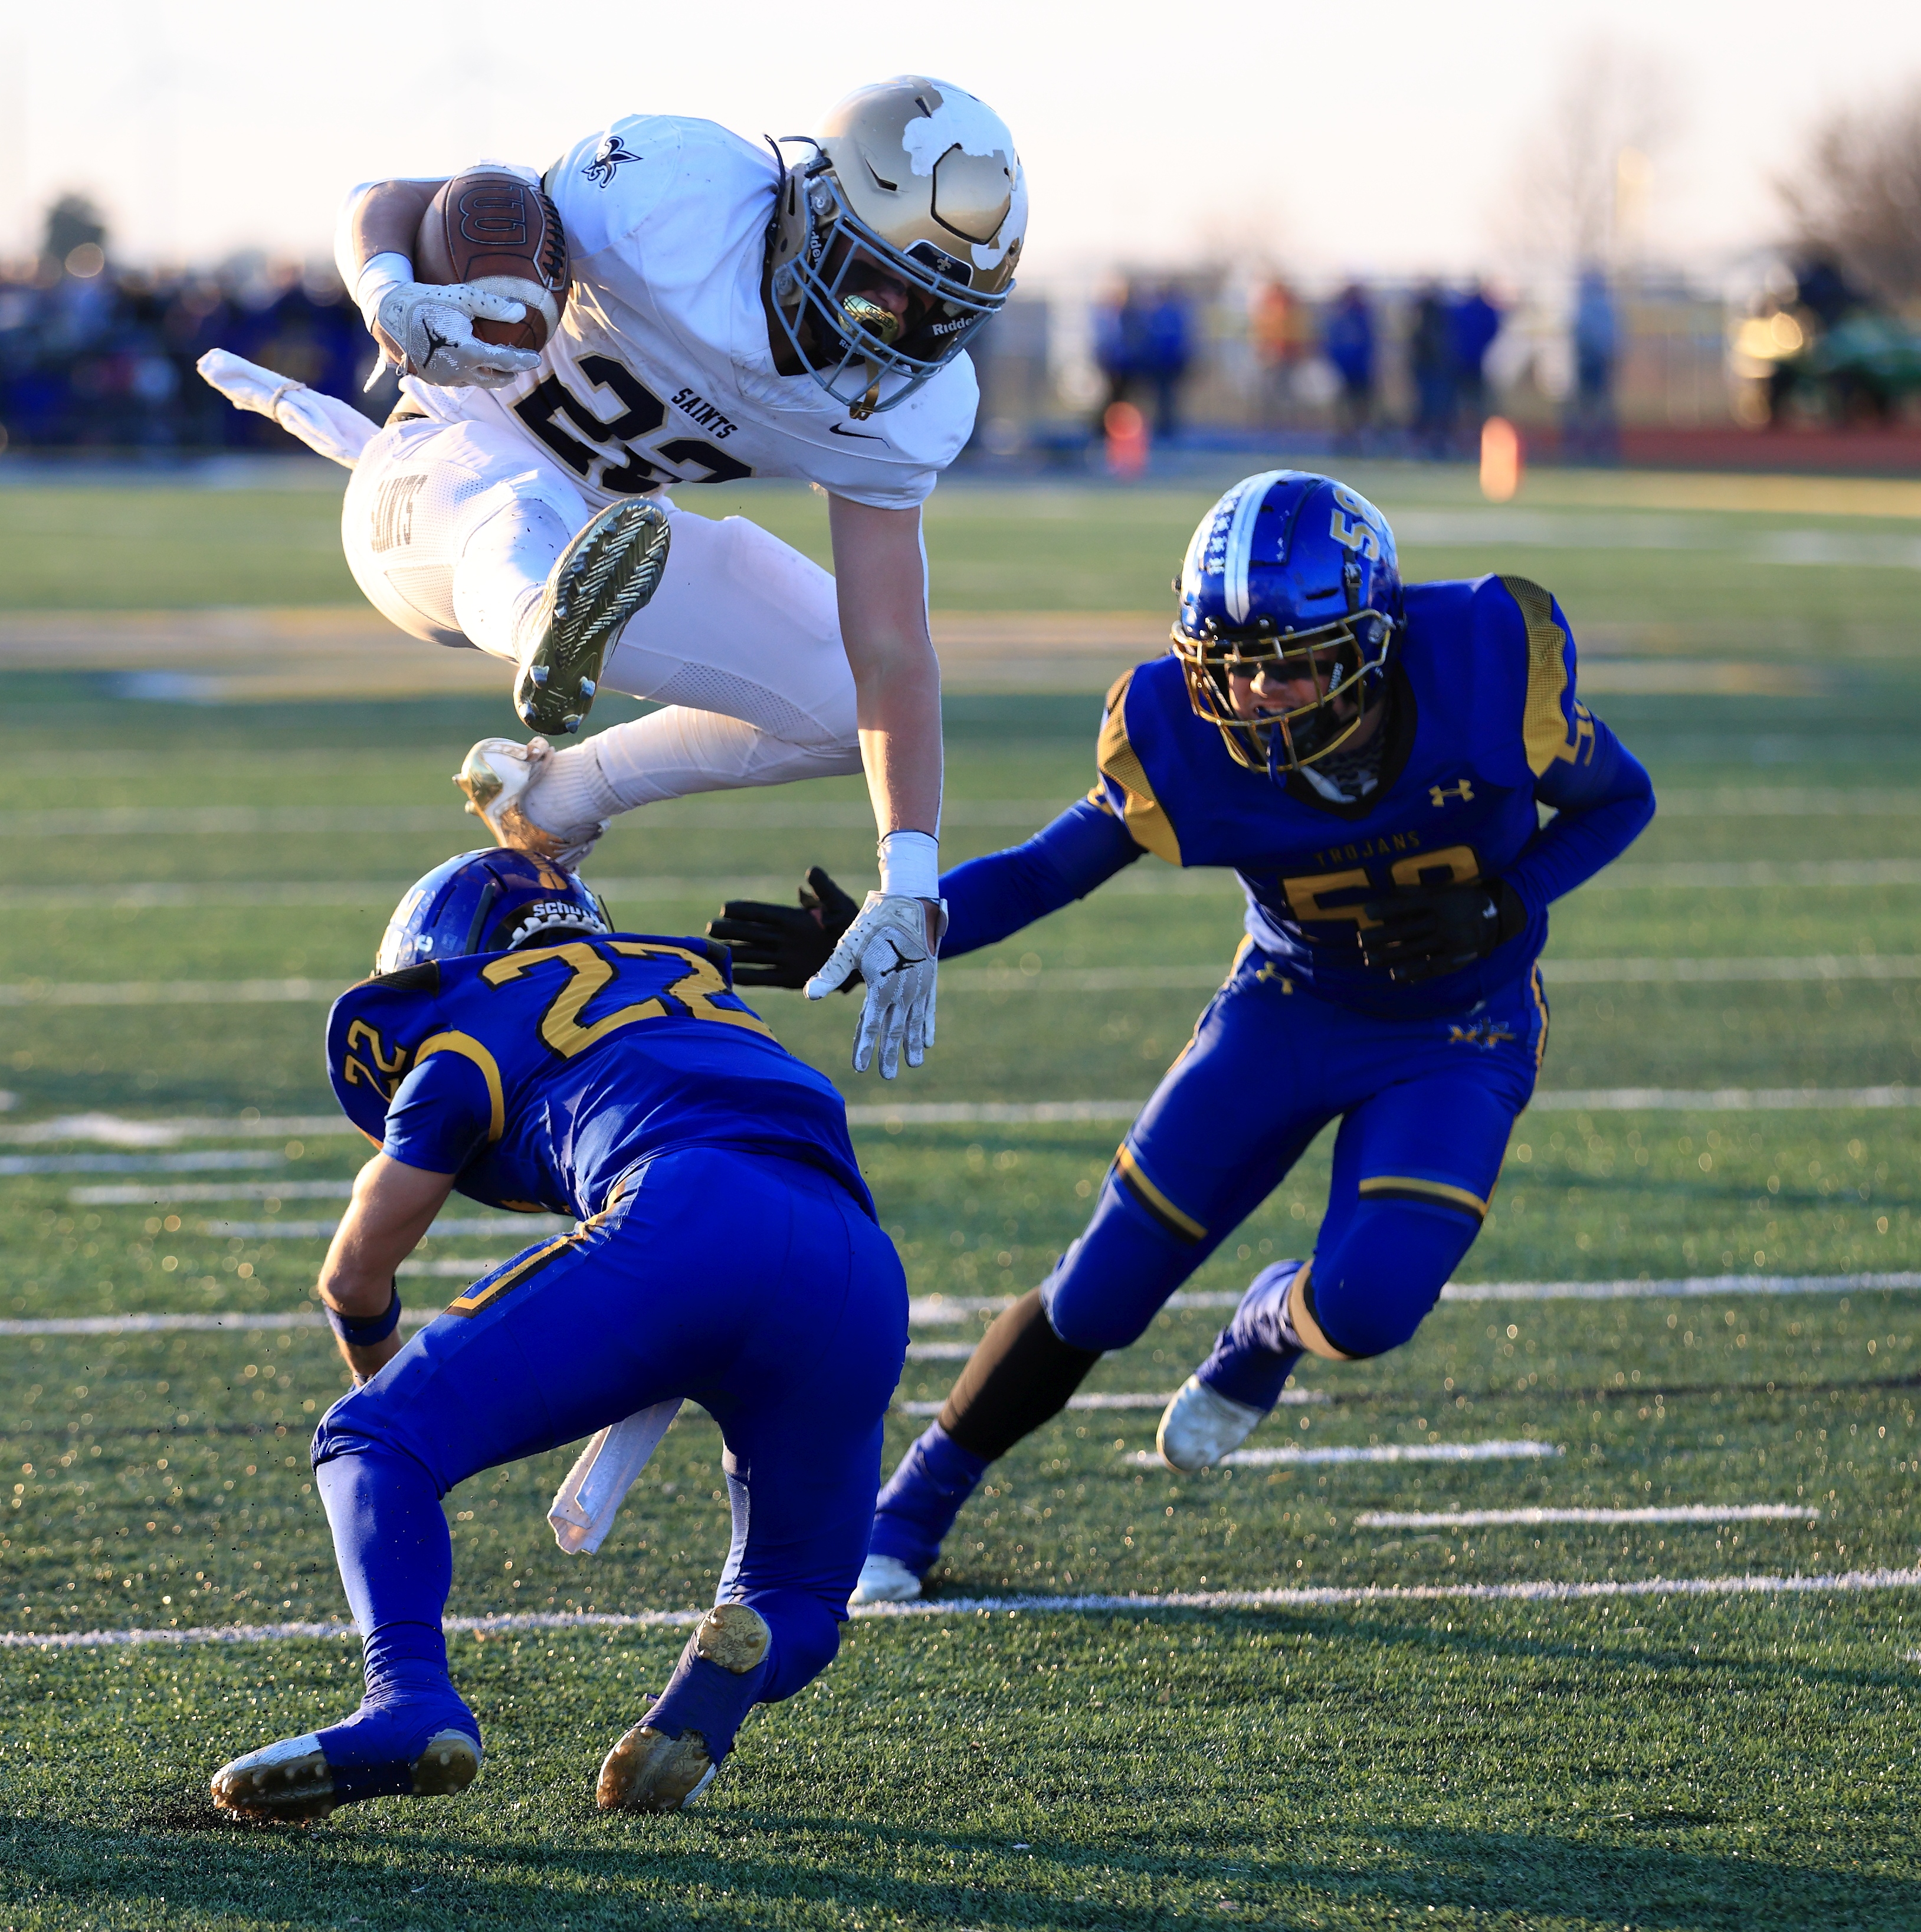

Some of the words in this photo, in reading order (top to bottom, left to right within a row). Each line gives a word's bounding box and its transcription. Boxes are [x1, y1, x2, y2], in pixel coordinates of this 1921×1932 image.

[932, 311, 981, 336] Ridde
[670, 387, 739, 440] SAINTS
[1312, 829, 1421, 868] TROJANS
[532, 899, 592, 918] schu
[478, 940, 779, 1062] 22
[343, 1017, 409, 1104] 22
